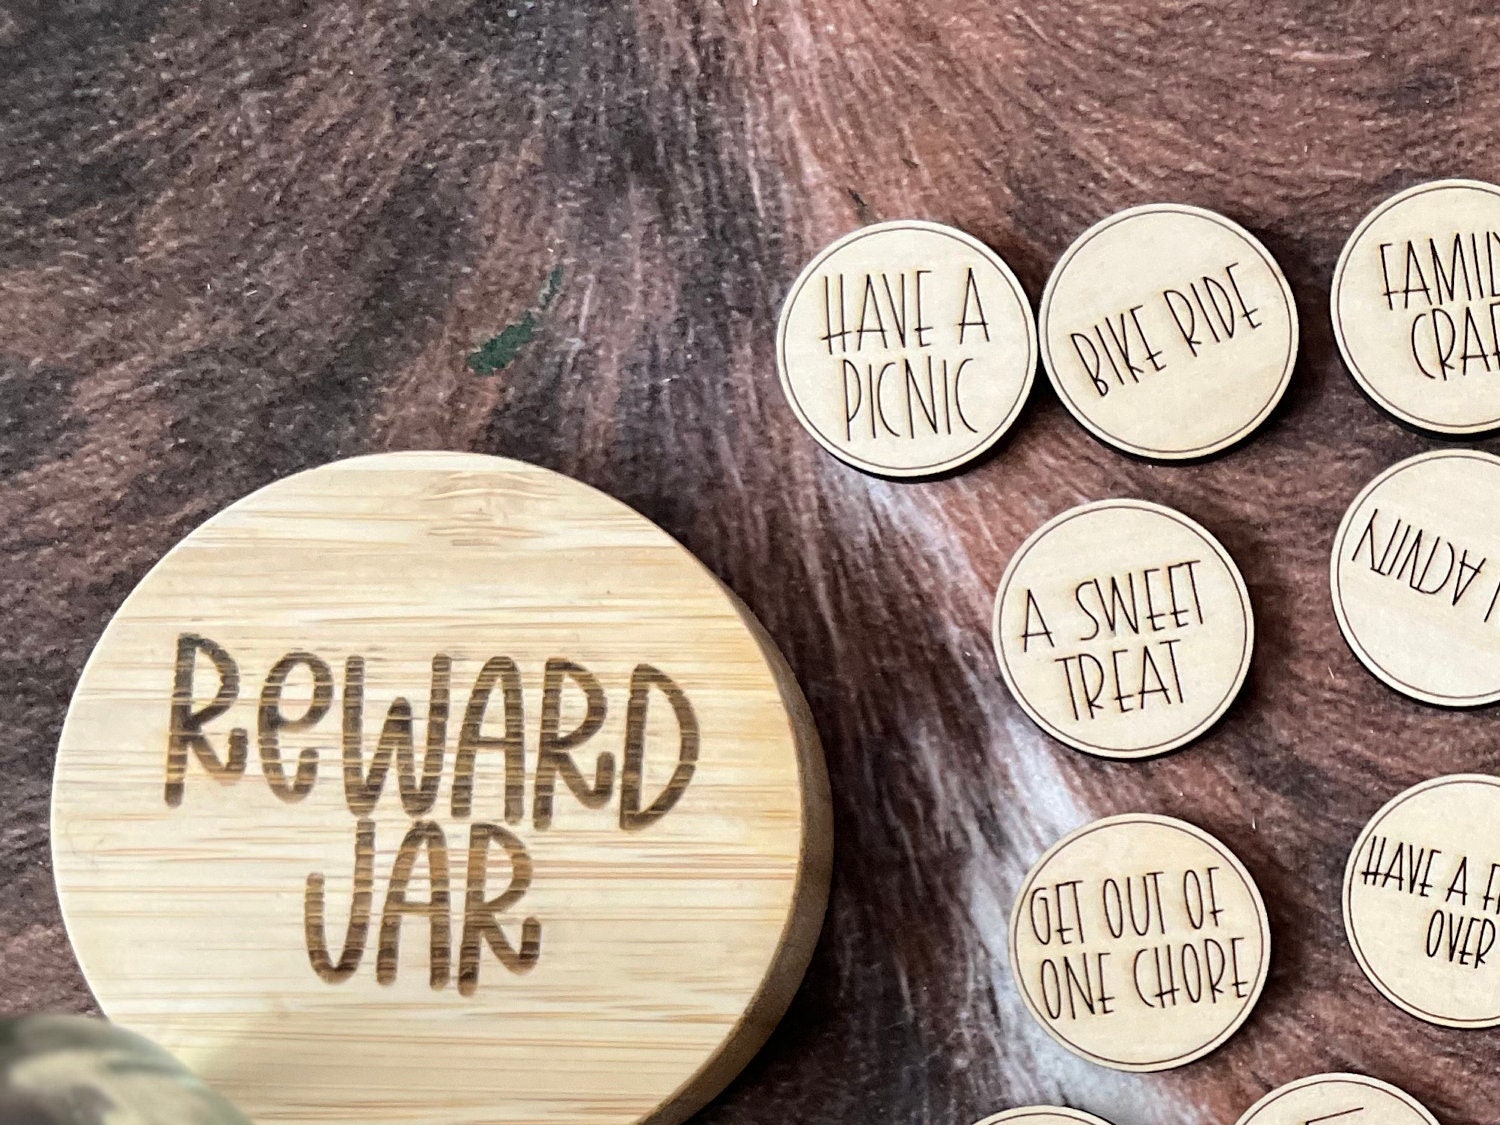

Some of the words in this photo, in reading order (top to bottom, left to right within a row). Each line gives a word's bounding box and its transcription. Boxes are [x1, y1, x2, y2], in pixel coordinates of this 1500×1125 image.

[820, 269, 934, 356] HAVE
[956, 267, 991, 345] A
[1069, 304, 1167, 398] BIKE
[1162, 261, 1263, 358] RIDE
[841, 355, 979, 442] PICNIC
[1019, 588, 1054, 647] A
[1074, 559, 1204, 642] SWEET
[1053, 638, 1184, 722] TREAT
[304, 818, 542, 997] JAR
[1029, 879, 1085, 946] GET
[1102, 871, 1166, 939] OUT
[1182, 866, 1224, 930] OF
[1360, 835, 1443, 898] HAVE
[1444, 855, 1468, 907] A
[1040, 952, 1116, 1021] ONE
[1132, 936, 1249, 1009] CHORE
[1425, 908, 1497, 970] OVER
